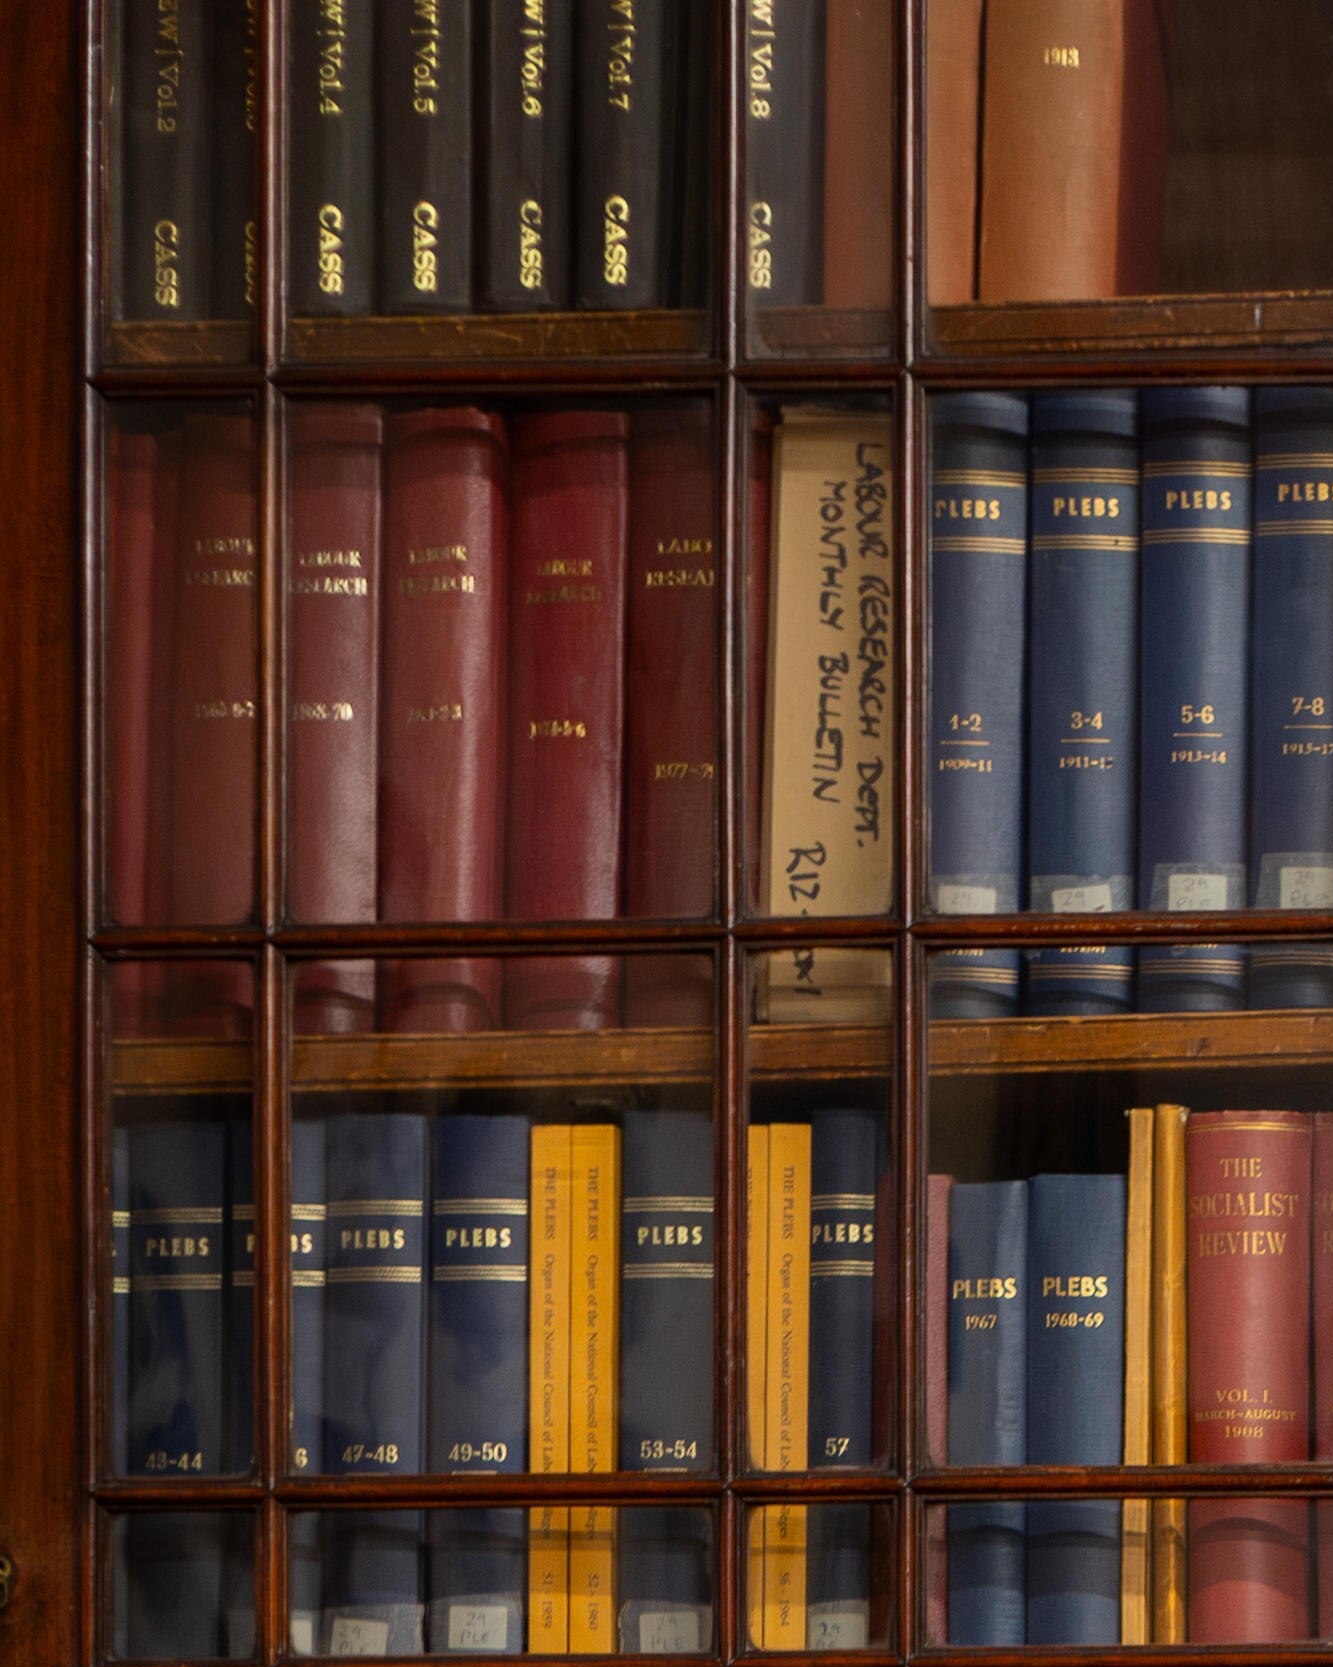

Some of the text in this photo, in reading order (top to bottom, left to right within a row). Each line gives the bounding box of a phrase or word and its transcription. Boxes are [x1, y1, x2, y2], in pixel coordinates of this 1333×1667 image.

[319, 41, 345, 117] Vol.4
[412, 41, 440, 116] Vol.5
[520, 43, 546, 119] Vol.6
[608, 36, 635, 112] Vol.7
[750, 43, 775, 120] Vol.8
[157, 63, 180, 132] Vol.2
[318, 203, 344, 295] CASS
[412, 200, 439, 292] CASS
[519, 200, 543, 290] CASS
[604, 194, 630, 286] CASS
[750, 201, 773, 290] CASS
[155, 219, 180, 308] CASS
[854, 442, 890, 559] LABOUR
[935, 499, 1000, 520] PLEBS
[1053, 497, 1119, 518] PLEBS
[1165, 490, 1232, 511] PLEBS
[818, 480, 849, 631] MONTHLY
[855, 575, 890, 738] RESEARCH
[1181, 705, 1215, 724] 5-6
[1291, 697, 1325, 716] 7-8
[812, 652, 850, 803] BULLETIN
[949, 713, 983, 732] 1-2
[1070, 711, 1103, 730] 3-4
[1219, 1157, 1264, 1179] THE
[1189, 1192, 1300, 1218] SOCIALIST
[340, 1229, 406, 1250] PLEBS
[446, 1227, 512, 1248] PLEBS
[637, 1225, 703, 1246] PLEBS
[813, 1223, 874, 1244] PLEBS
[1199, 1229, 1288, 1257] REVIEW
[145, 1236, 210, 1257] PLEBS
[953, 1277, 1018, 1300] PLEBS
[1042, 1275, 1109, 1298] PLEBS
[965, 1314, 998, 1331] 1967
[1045, 1313, 1105, 1330] 1968-69
[341, 1443, 399, 1465] 47-48
[448, 1442, 508, 1464] 49-50
[640, 1439, 698, 1461] 53-54
[824, 1437, 850, 1457] 57
